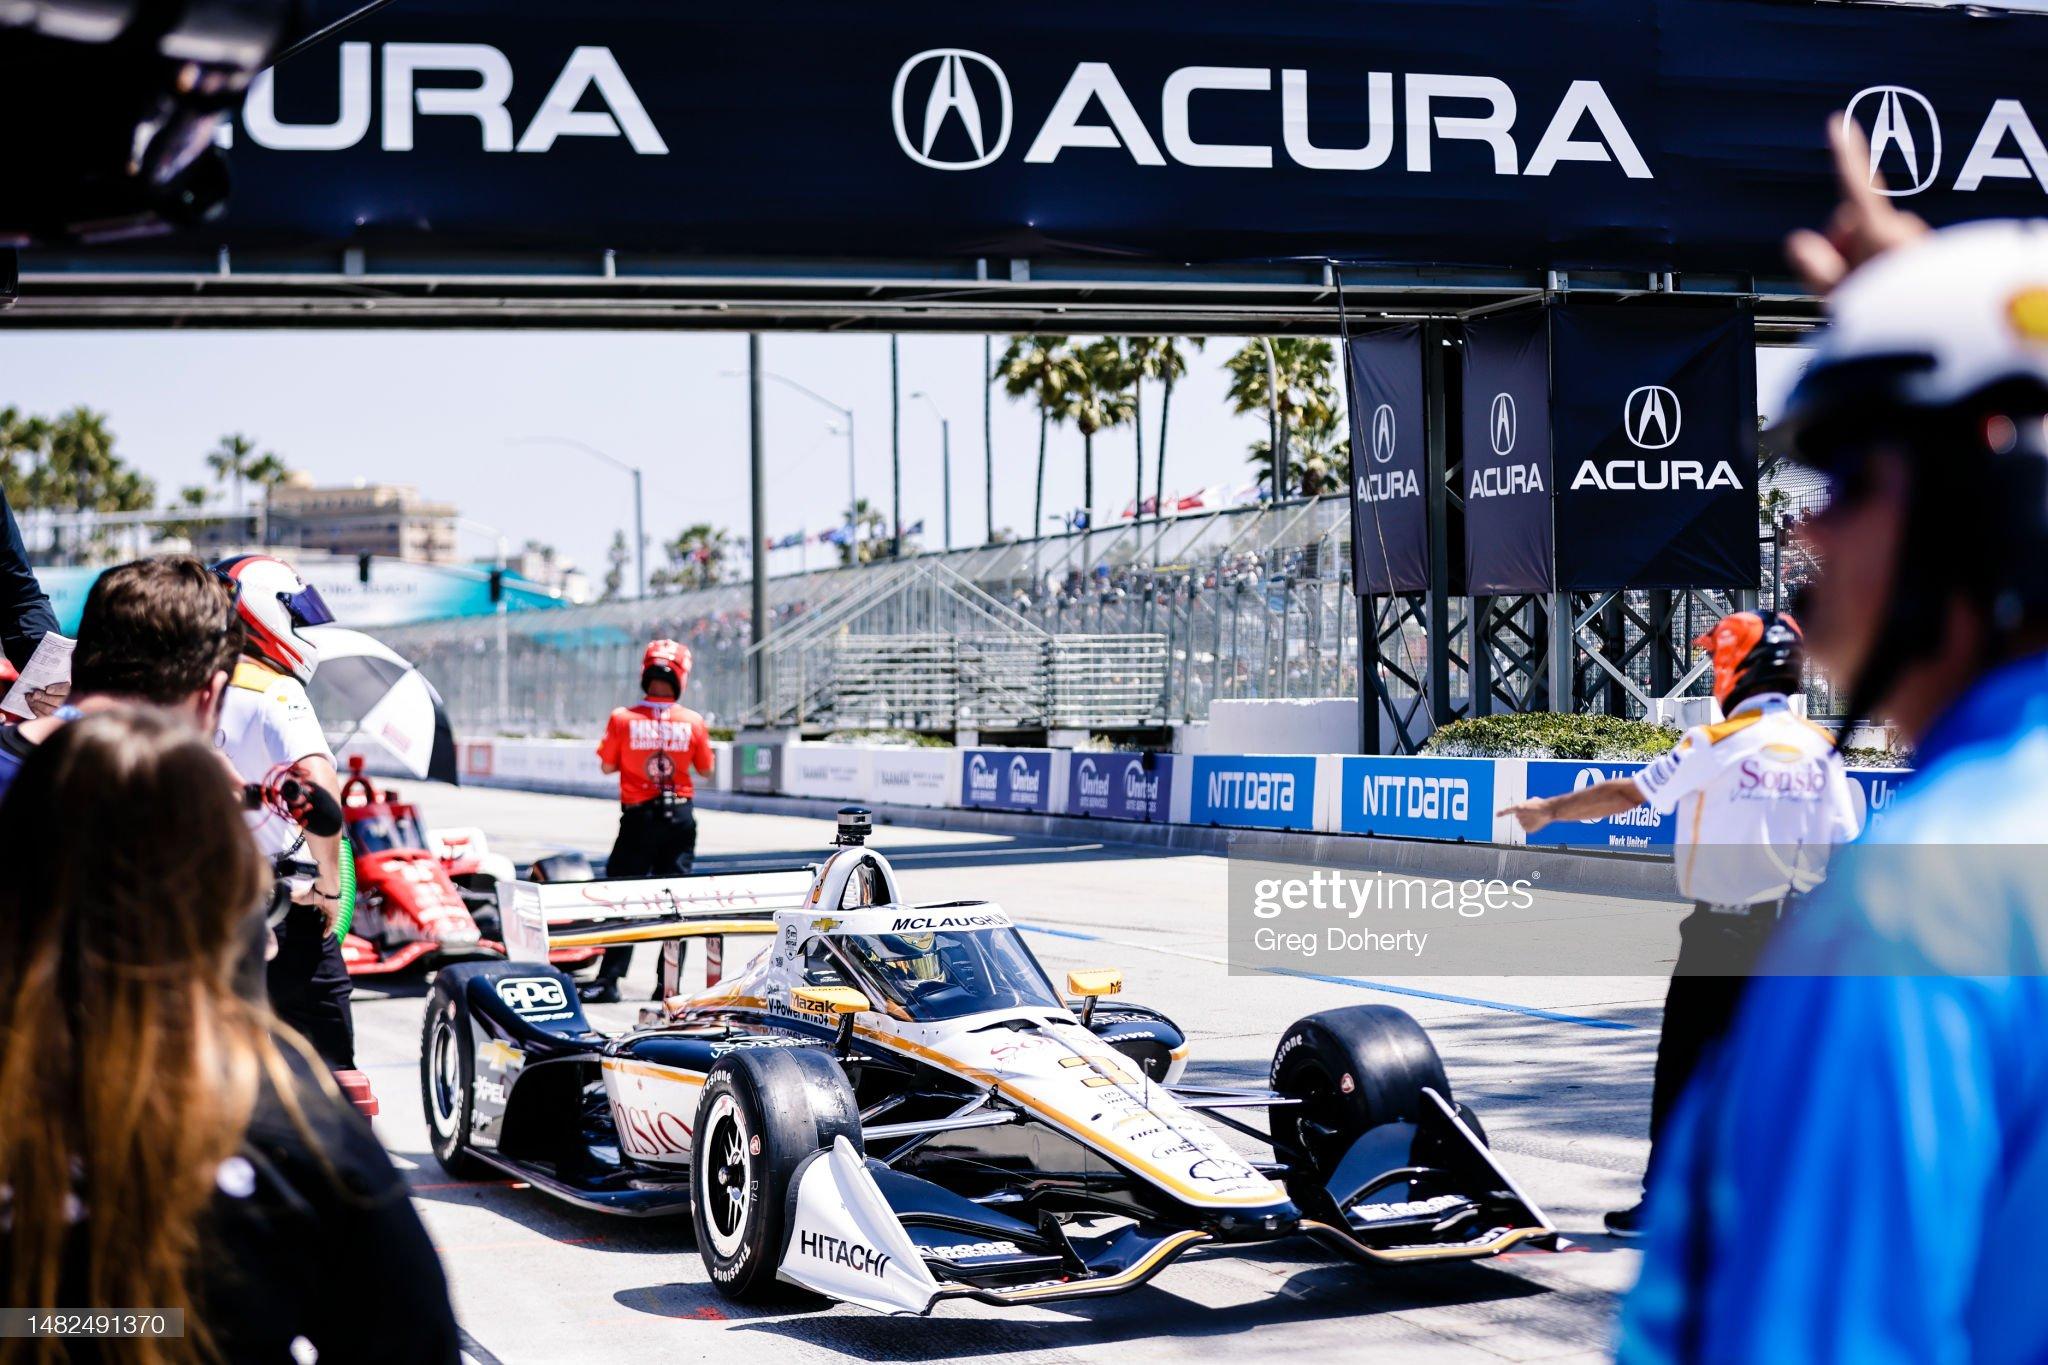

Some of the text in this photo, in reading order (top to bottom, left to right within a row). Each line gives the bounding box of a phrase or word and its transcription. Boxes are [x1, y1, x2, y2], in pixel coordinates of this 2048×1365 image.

[242, 42, 669, 154] URA
[1023, 62, 1654, 178] ACURA
[1357, 468, 1420, 502] ACURA
[1470, 462, 1544, 499] ACURA
[1570, 459, 1744, 490] ACURA
[1081, 772, 1109, 796] United
[1208, 771, 1244, 809] NTT
[1362, 774, 1406, 817] NTT
[1609, 834, 1626, 847] Work
[502, 982, 562, 1009] PPG
[790, 994, 837, 1014] Mazak
[713, 1241, 752, 1282] Firestone
[800, 1229, 892, 1278] HITACHI
